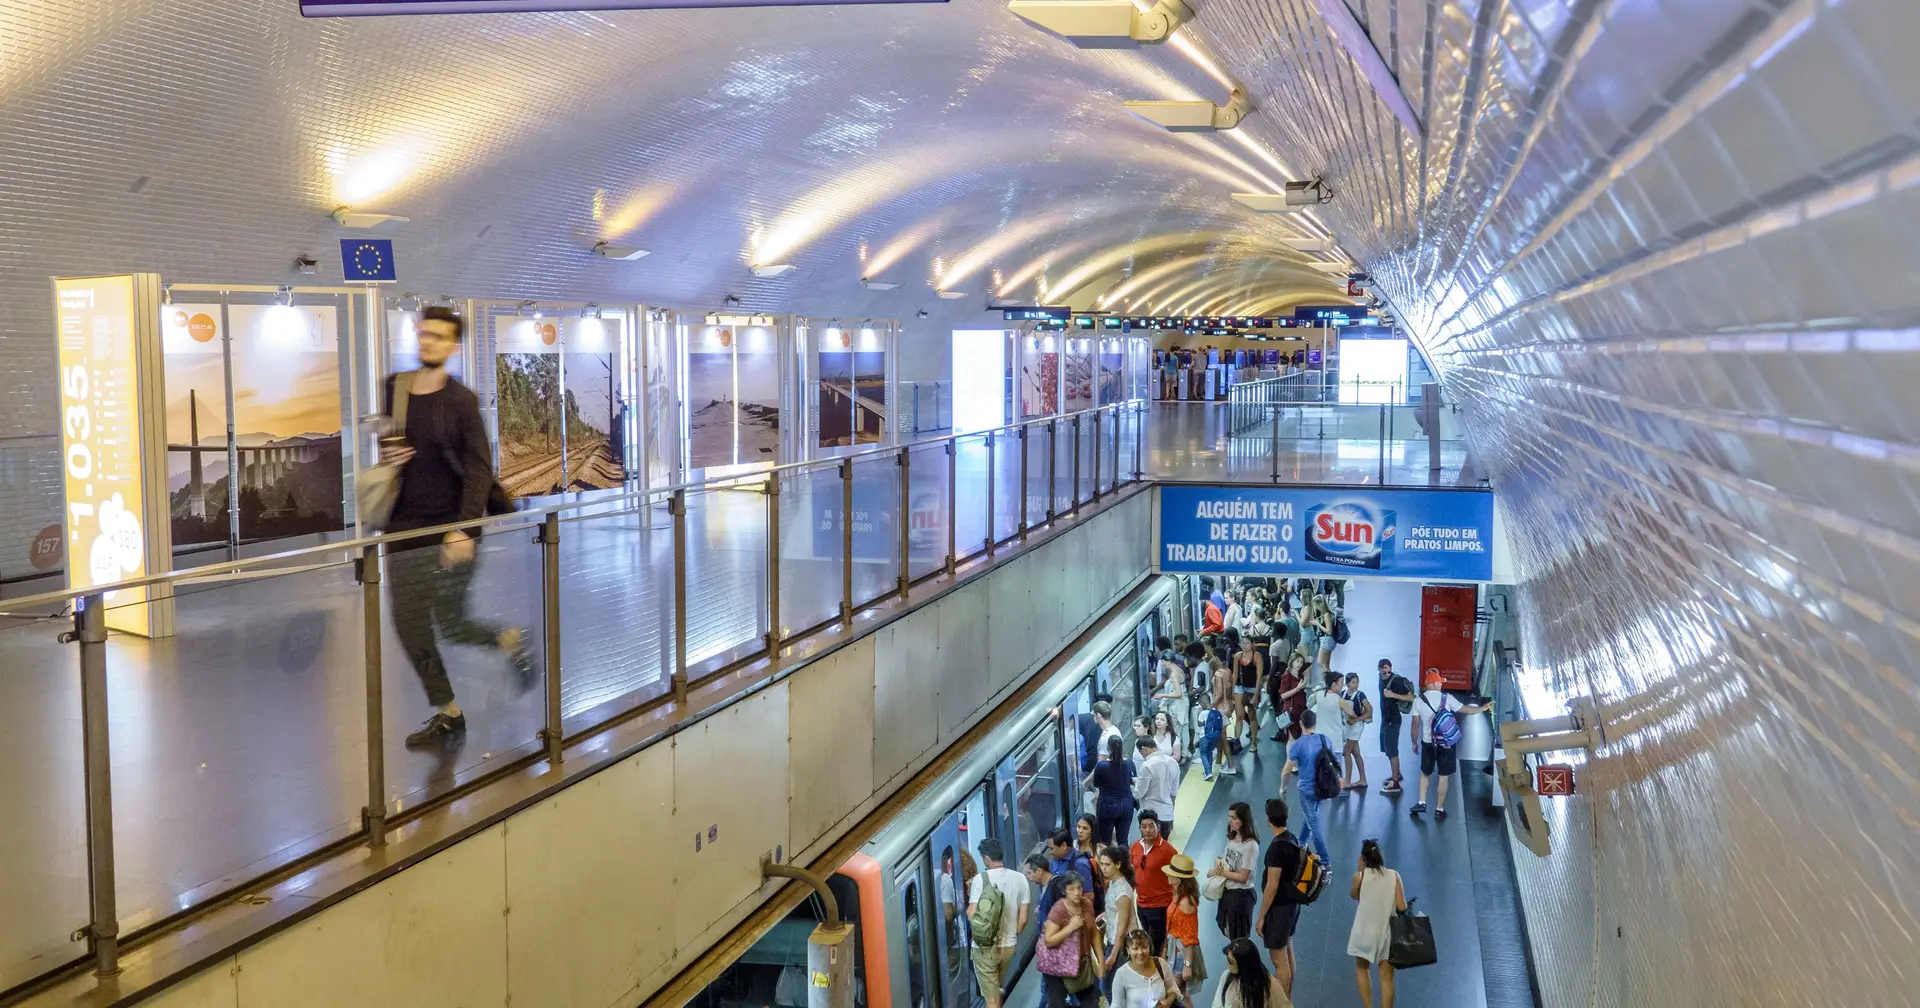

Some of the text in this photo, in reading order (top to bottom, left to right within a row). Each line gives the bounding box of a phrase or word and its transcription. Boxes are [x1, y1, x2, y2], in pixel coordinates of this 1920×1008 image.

[1196, 497, 1293, 520] ALGUÉM TEM
[1210, 523, 1293, 542] DE FAZER O
[1317, 513, 1373, 544] Sun
[1412, 524, 1477, 539] PÕE TUDO EM
[37, 536, 61, 554] 157
[1166, 544, 1293, 564] TRABALHO SUJO.
[1404, 539, 1484, 551] PRATOS LIMPOS.
[1325, 555, 1366, 566] EXTRA POWER
